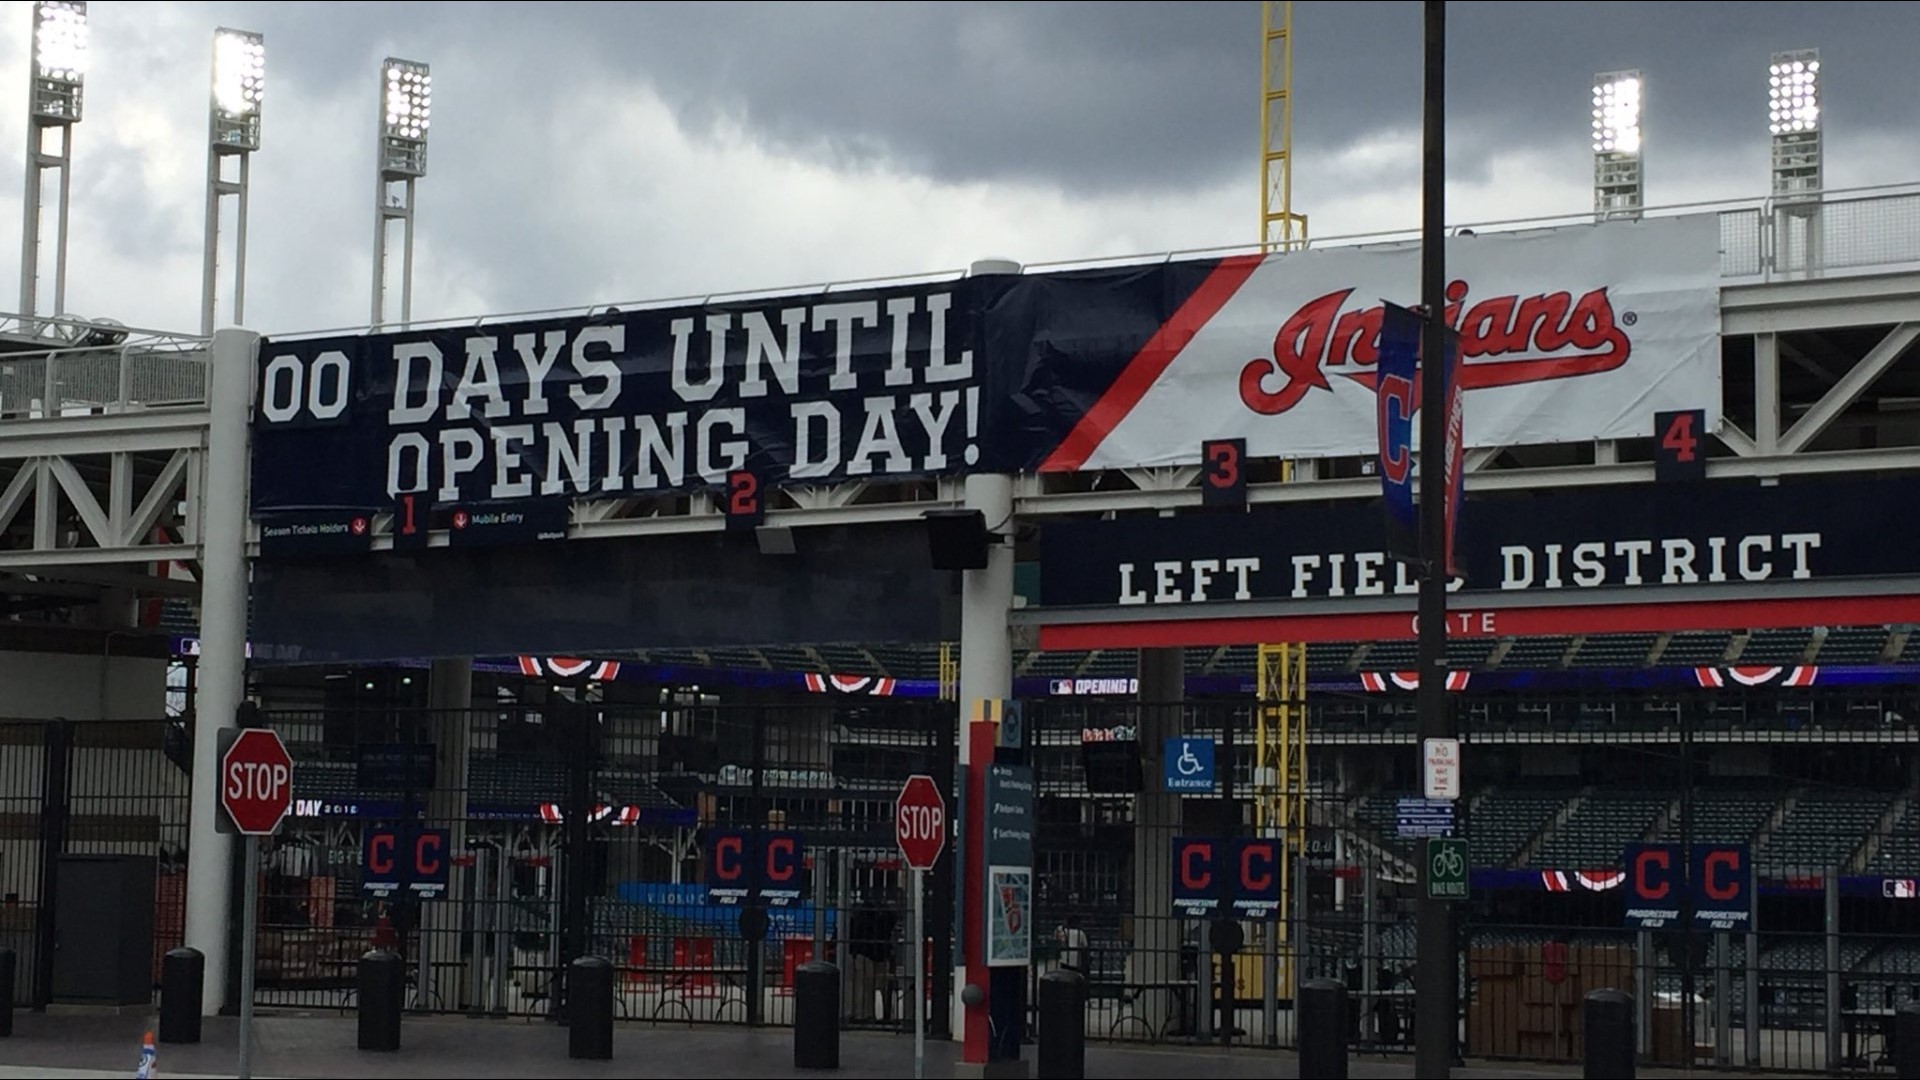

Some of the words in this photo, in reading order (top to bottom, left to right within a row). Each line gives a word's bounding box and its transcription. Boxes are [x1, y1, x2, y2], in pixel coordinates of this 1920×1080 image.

[263, 350, 350, 422] 00
[388, 325, 626, 424] DAYS
[671, 292, 974, 402] UNTIL
[1240, 280, 1632, 415] Inians
[386, 406, 750, 501] OPENING
[789, 385, 981, 479] DAY!
[1379, 373, 1412, 484] C
[1662, 413, 1697, 462] 4
[1208, 443, 1239, 488] 3
[731, 471, 757, 515] 2
[264, 526, 291, 537] Season
[402, 495, 416, 535] 1
[501, 512, 524, 524] Entry
[1119, 557, 1260, 605] LEFT
[1291, 552, 1466, 600] FIEL
[1501, 533, 1821, 590] DISTRICT
[1412, 612, 1496, 635] TE
[1075, 679, 1128, 694] OPENING
[228, 761, 288, 801] STOP
[1168, 777, 1212, 788] Entrance
[296, 800, 323, 816] DAY
[900, 804, 942, 840] STOP
[370, 834, 395, 875] C
[415, 834, 441, 875] C
[716, 837, 742, 880] C
[766, 838, 794, 881] C
[1181, 844, 1211, 890] C
[1241, 845, 1273, 891] C
[1635, 851, 1669, 899] C
[1705, 851, 1739, 899] C
